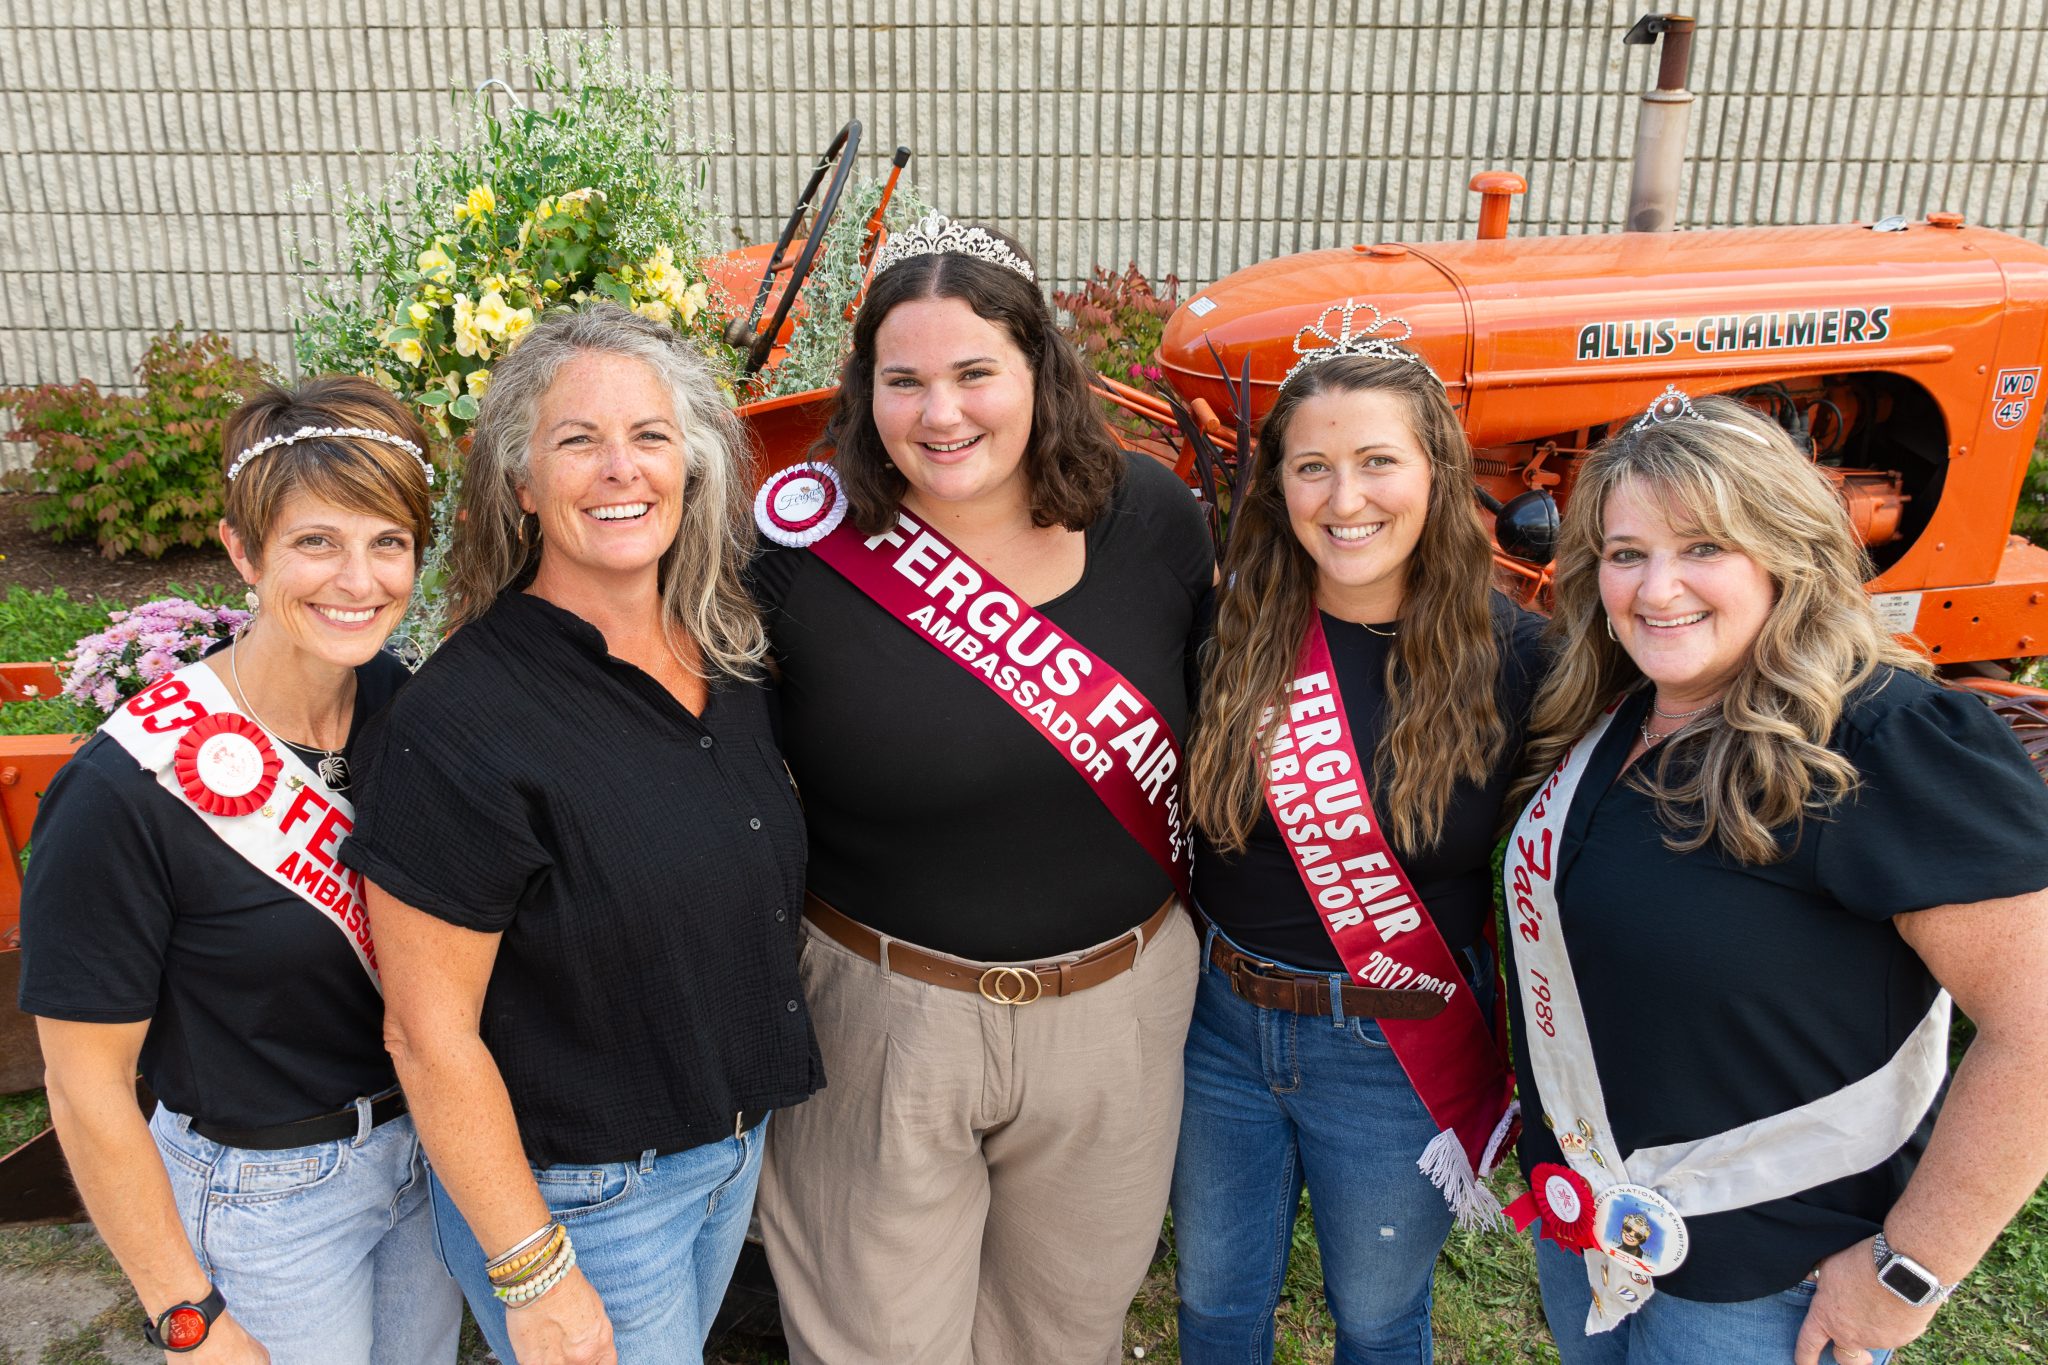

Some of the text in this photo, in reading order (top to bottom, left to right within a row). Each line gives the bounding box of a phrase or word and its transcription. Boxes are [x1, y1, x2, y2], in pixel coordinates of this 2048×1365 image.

[1576, 307, 1890, 361] ALLIS-CHALMERS
[1998, 402, 2024, 421] 45
[2002, 374, 2035, 394] WD
[864, 512, 1092, 697] FERGUS
[1086, 682, 1178, 805] FAIR
[907, 605, 1114, 783] AMBASSADOR
[1284, 671, 1421, 943] FERGUS FAIR
[1514, 828, 1553, 943] Fair
[1530, 968, 1556, 1038] 1989
[1619, 1188, 1666, 1210] NATIONAL
[1668, 1211, 1684, 1262] EXHIBITION
